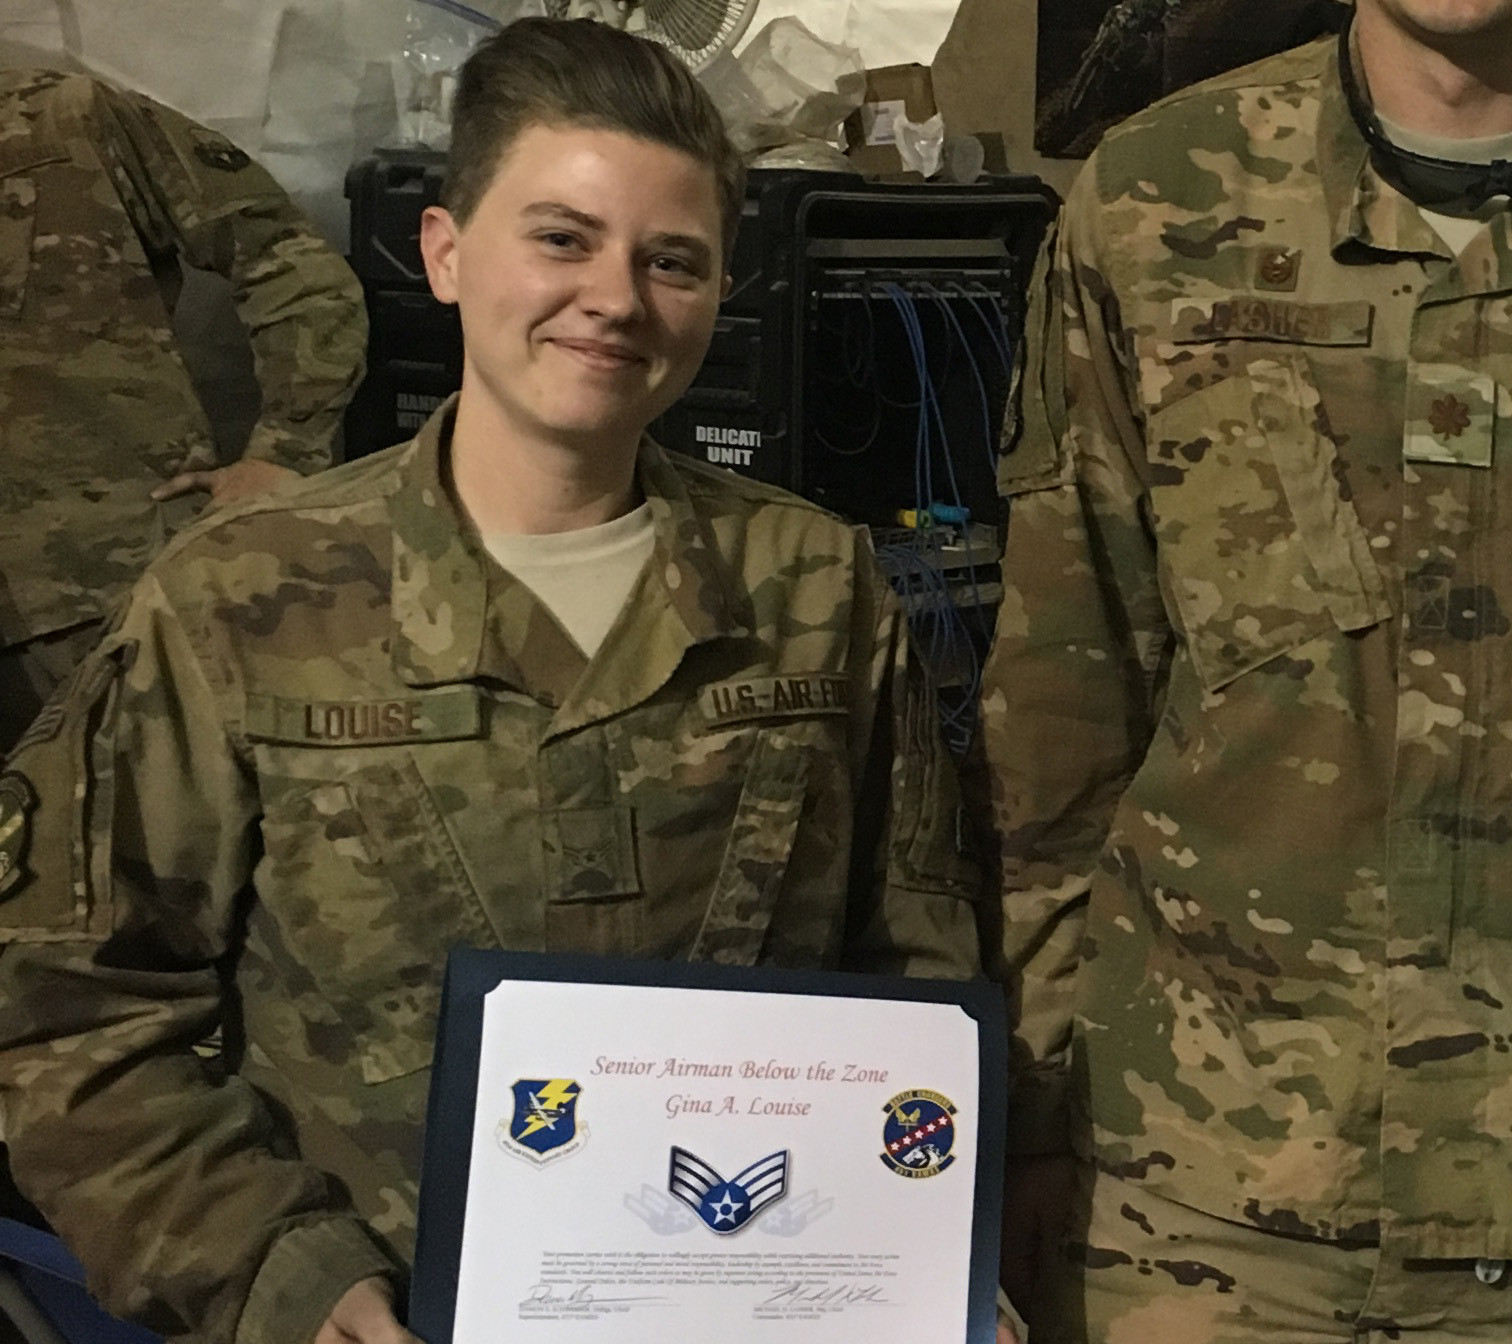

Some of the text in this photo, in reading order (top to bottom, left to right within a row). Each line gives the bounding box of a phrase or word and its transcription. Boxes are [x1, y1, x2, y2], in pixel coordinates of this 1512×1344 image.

[707, 446, 754, 466] UNIT
[773, 678, 815, 712] AIR
[304, 700, 423, 740] LOUISE
[590, 1055, 890, 1084] Senior Airman Below the Zone
[664, 1094, 812, 1120] Gina A. Louise
